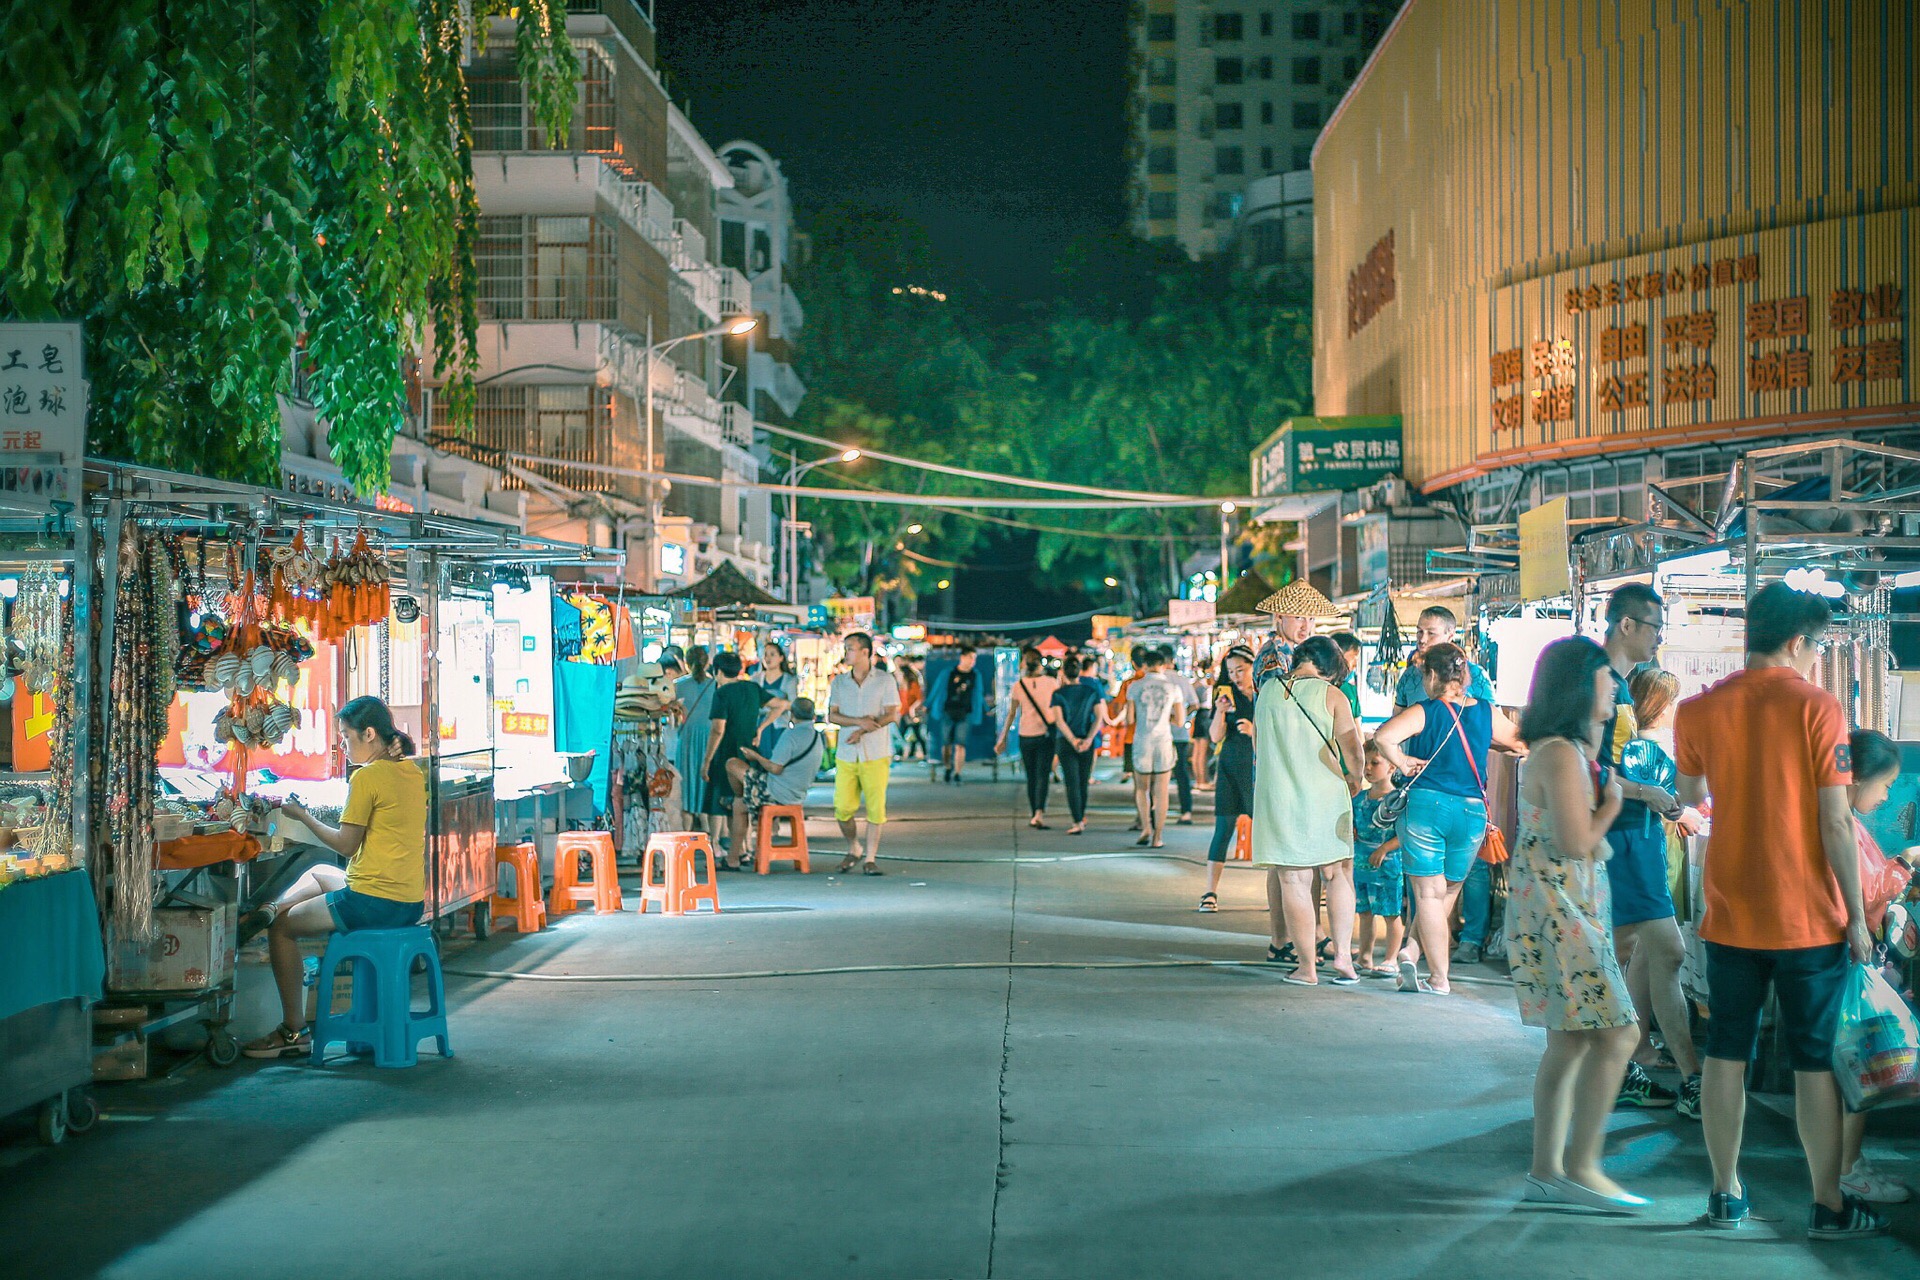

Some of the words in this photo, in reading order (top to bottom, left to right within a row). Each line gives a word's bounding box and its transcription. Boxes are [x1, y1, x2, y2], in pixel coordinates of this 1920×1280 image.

[1564, 254, 1760, 316] 社会主义核心价值观
[1490, 347, 1523, 388] 富强
[1600, 320, 1646, 365] 自由
[1661, 309, 1717, 354] 平等
[1746, 296, 1809, 343] 爱国
[1829, 282, 1902, 331] 敬业
[1, 343, 64, 374] 工皂
[3, 384, 67, 417] 泡球
[1491, 394, 1523, 432] 文明
[1531, 384, 1574, 424] 和谐
[1599, 372, 1648, 413] 公正
[1661, 362, 1717, 404] 法治
[1746, 348, 1811, 394] 诚信
[1829, 337, 1902, 384] 友善
[3, 430, 42, 450] 元起
[1298, 439, 1400, 461] 第一农贸市场
